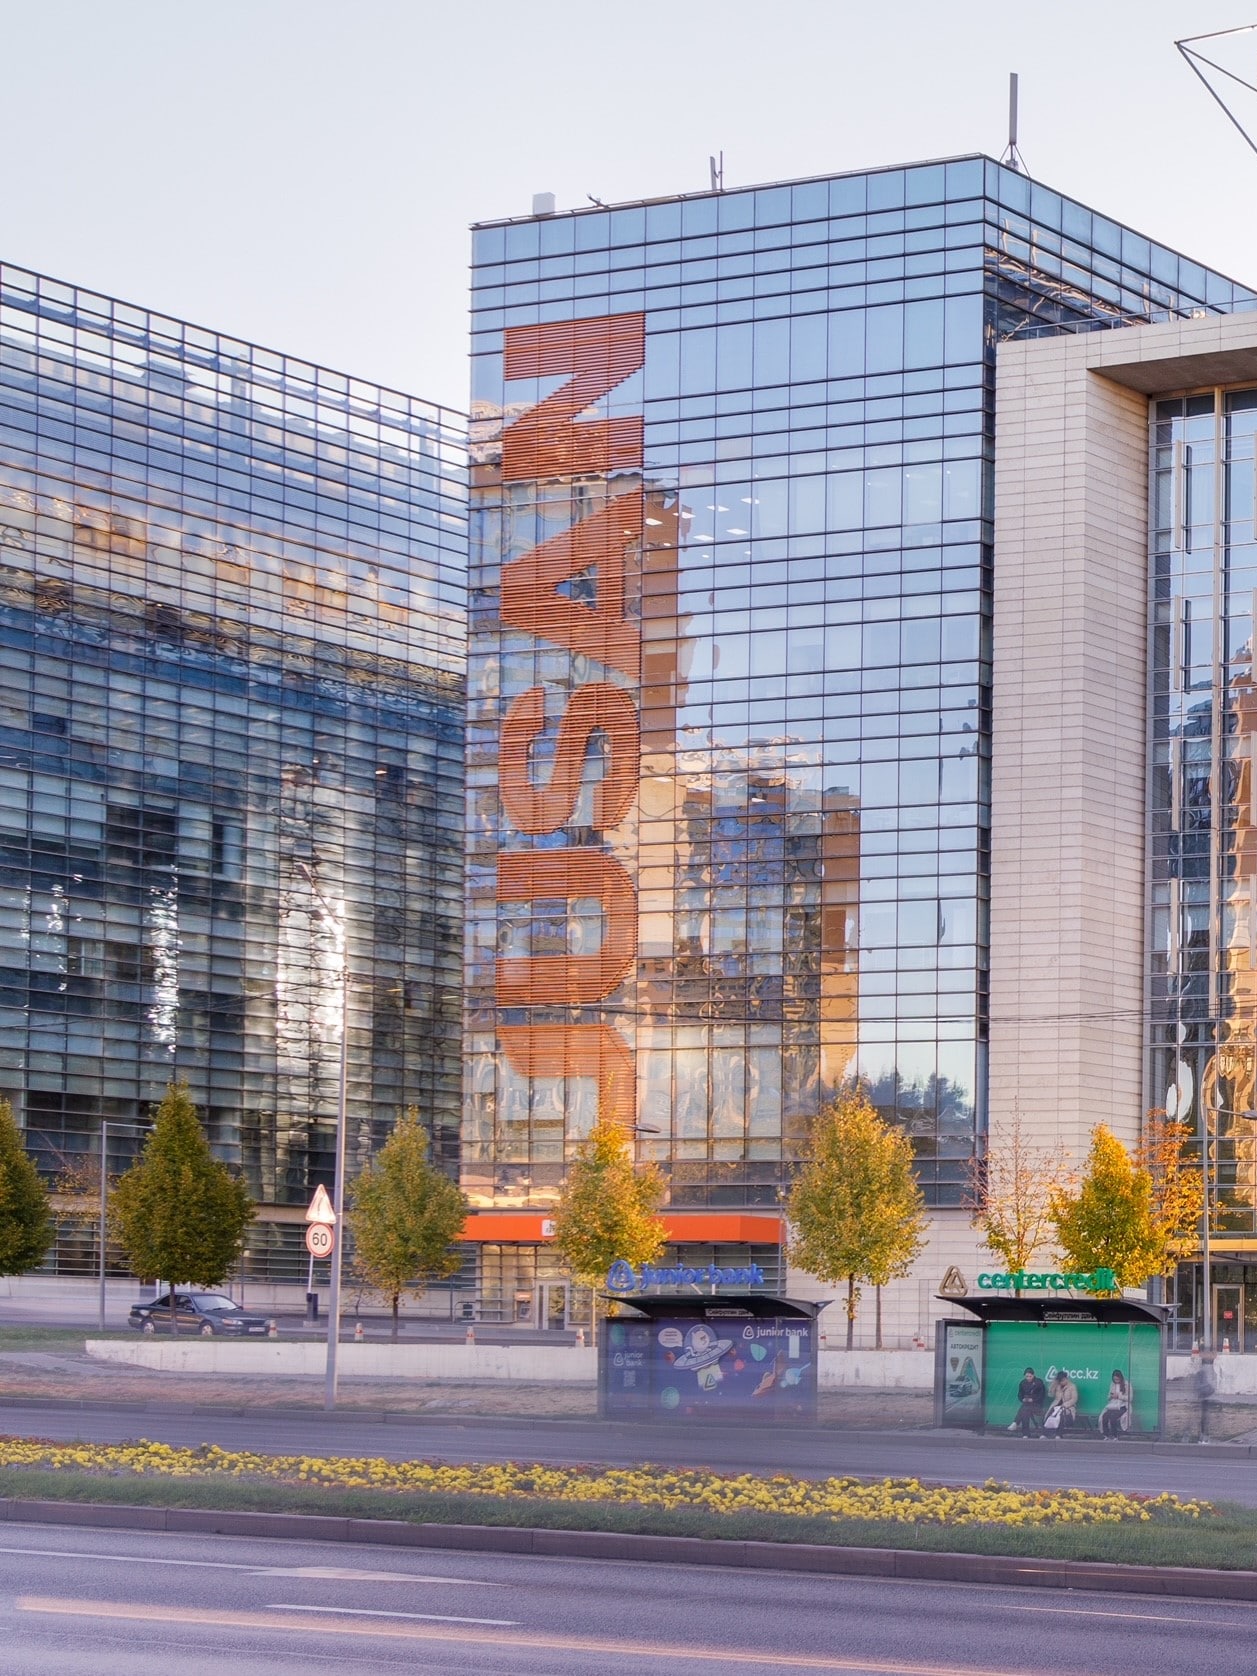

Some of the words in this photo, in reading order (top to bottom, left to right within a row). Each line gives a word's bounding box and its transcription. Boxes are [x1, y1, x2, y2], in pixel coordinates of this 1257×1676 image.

[495, 311, 646, 1140] JUSAN
[312, 1232, 328, 1247] 60
[640, 1262, 705, 1289] junior
[708, 1263, 764, 1285] bank
[977, 1267, 1116, 1291] centercredit
[756, 1326, 784, 1339] junior
[785, 1327, 808, 1337] bank
